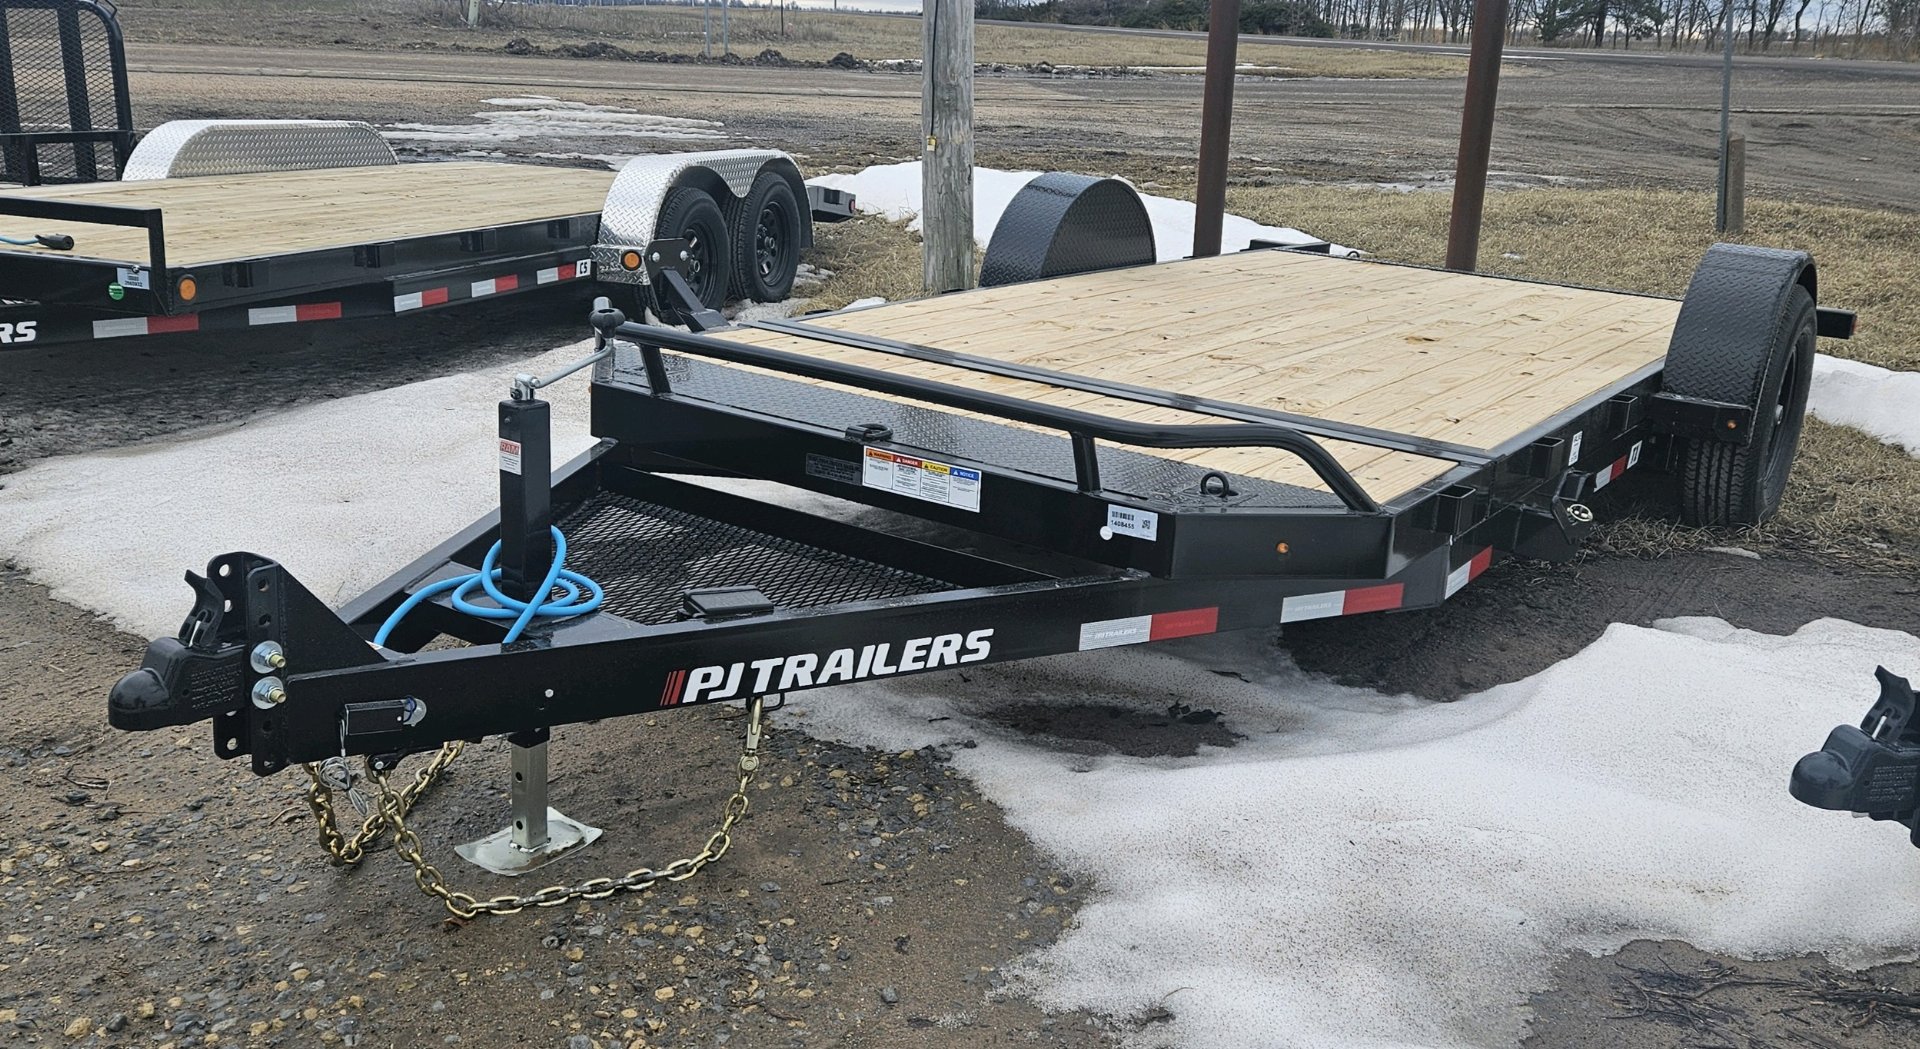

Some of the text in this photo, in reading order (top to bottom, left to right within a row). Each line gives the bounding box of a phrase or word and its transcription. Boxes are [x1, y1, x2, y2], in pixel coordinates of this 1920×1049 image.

[902, 458, 918, 466] DANGER
[930, 464, 948, 473] CAUTION
[960, 470, 974, 478] NOTICE
[682, 628, 994, 703] PJ TRAILERS
